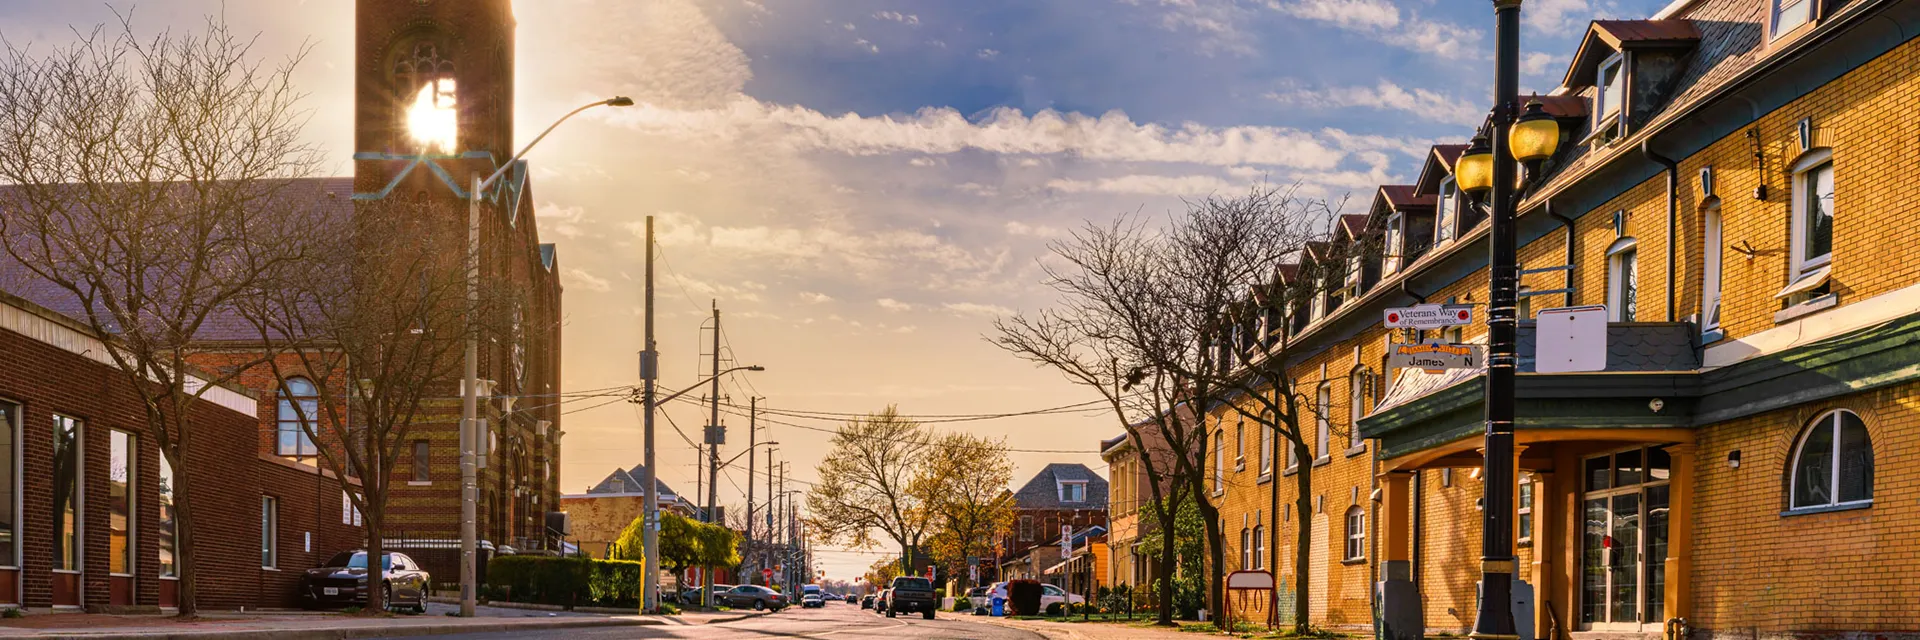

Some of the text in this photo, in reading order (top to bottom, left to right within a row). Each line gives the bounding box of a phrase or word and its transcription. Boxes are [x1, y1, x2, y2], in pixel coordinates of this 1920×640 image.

[1399, 308, 1458, 319] Veterans Way
[1408, 318, 1457, 326] Remembrance
[1409, 356, 1473, 367] James N
